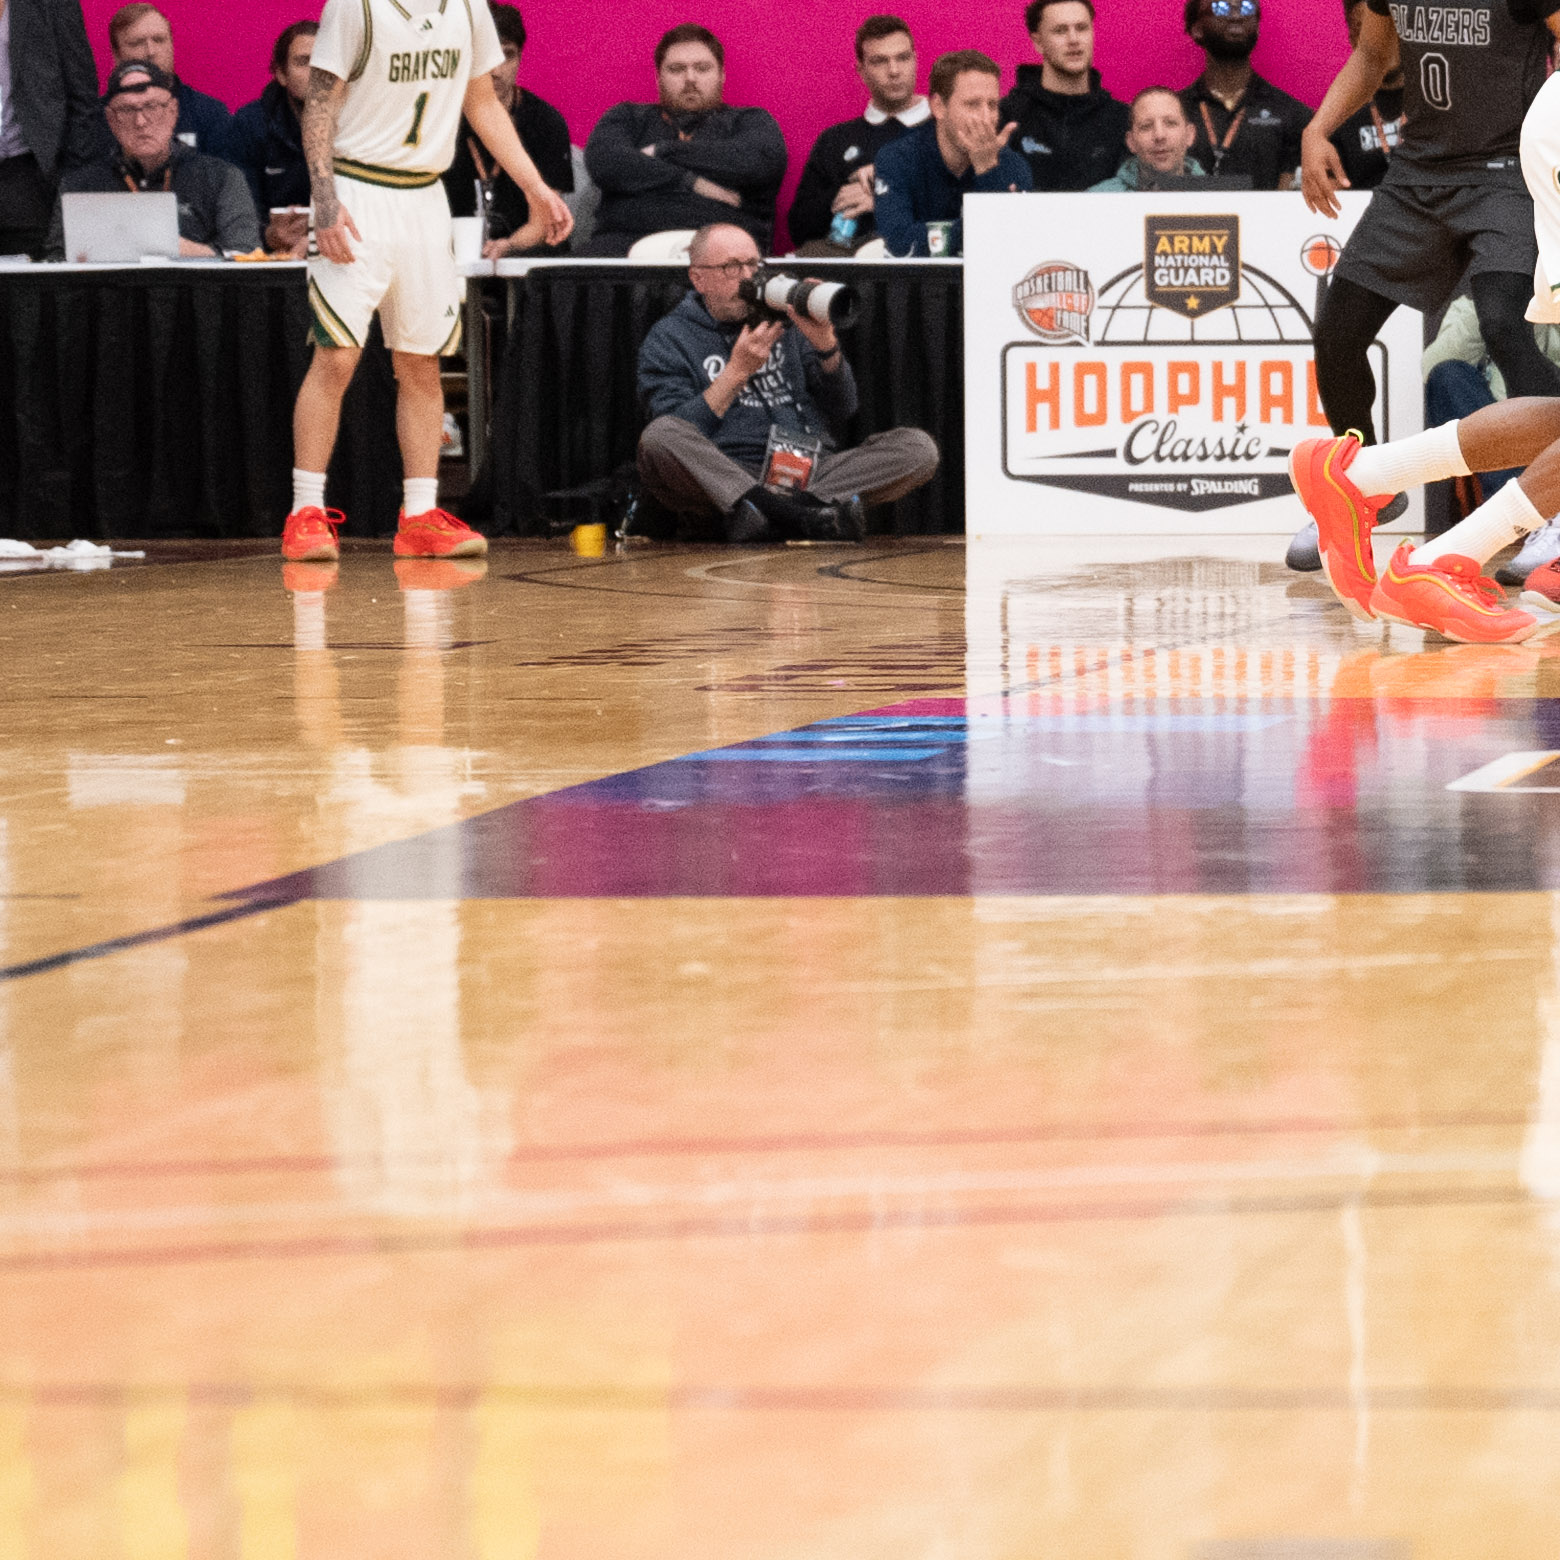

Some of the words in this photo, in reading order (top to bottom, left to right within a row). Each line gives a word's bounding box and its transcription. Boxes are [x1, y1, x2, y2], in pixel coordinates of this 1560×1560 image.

[1389, 3, 1490, 45] BLAZERS
[389, 49, 461, 83] GRAYSON
[1420, 52, 1452, 111] 0
[402, 92, 430, 147] 1
[1154, 255, 1229, 268] NATIONAL
[1156, 236, 1228, 254] ARMY
[1154, 268, 1231, 286] GUARD
[1025, 360, 1332, 433] HOOPHAL
[1123, 419, 1261, 466] Classic
[1190, 478, 1259, 496] SPALDING
